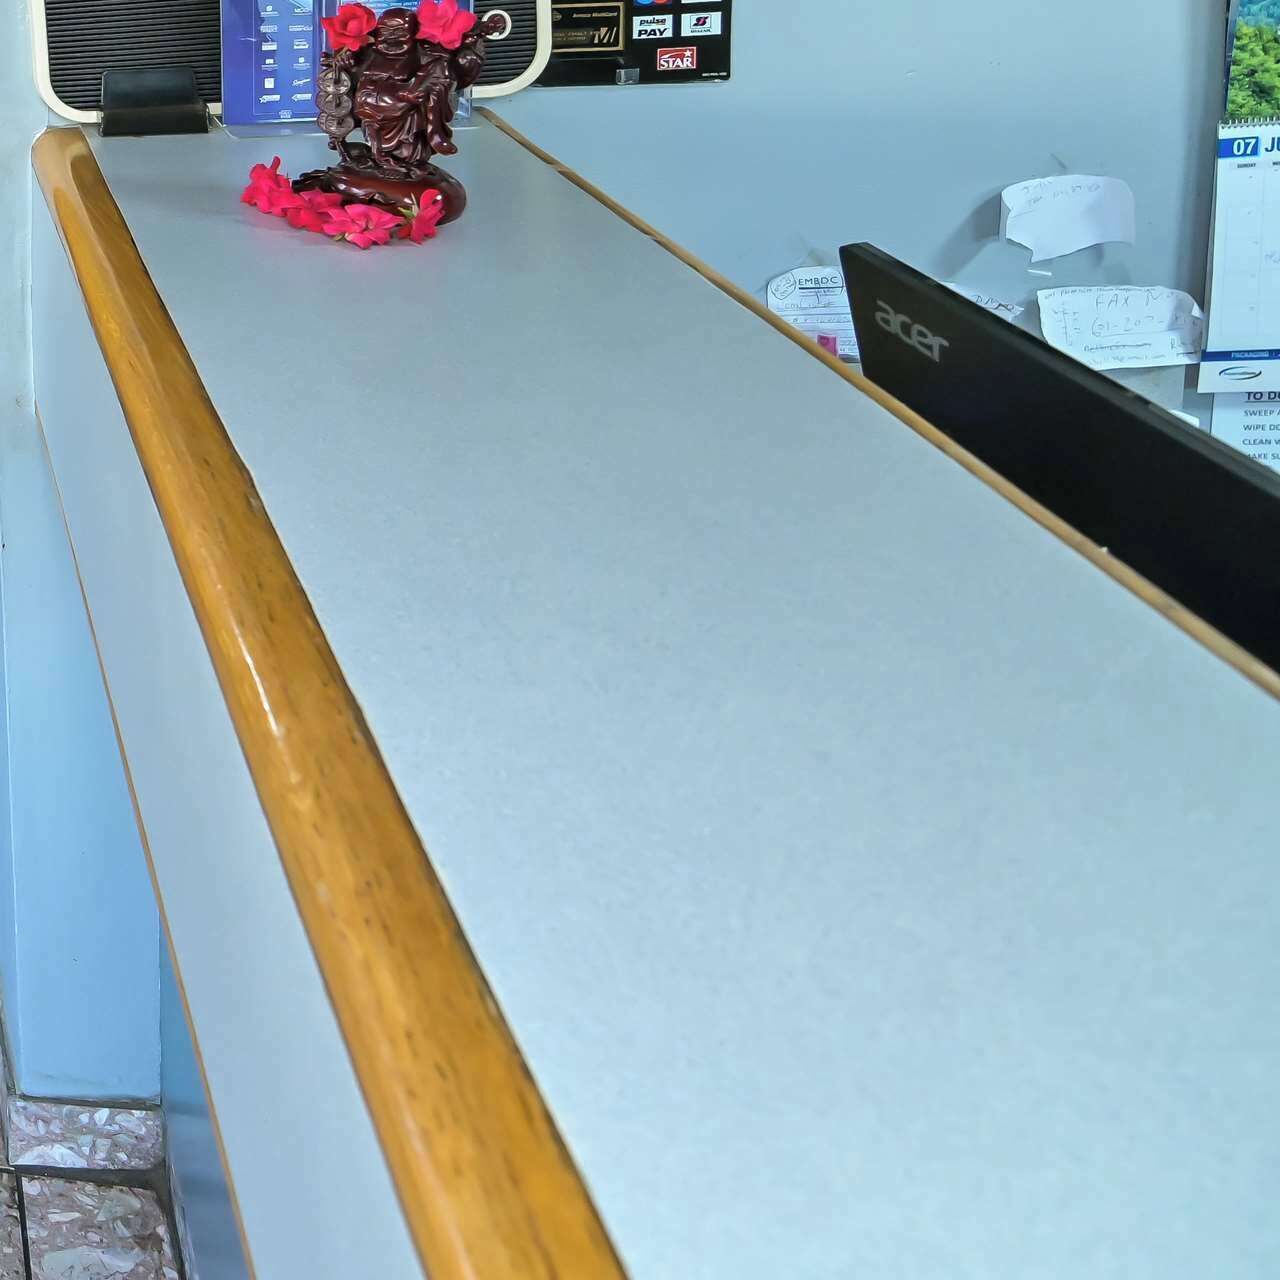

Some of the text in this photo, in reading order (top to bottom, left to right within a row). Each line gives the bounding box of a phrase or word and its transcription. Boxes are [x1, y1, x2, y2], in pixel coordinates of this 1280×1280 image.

[639, 16, 667, 26] pulse
[637, 28, 667, 38] PAY
[660, 57, 693, 70] STAR
[1232, 138, 1257, 156] 07
[874, 299, 950, 363] acer
[1245, 392, 1264, 401] TO
[1243, 409, 1275, 417] SWEEP
[1241, 438, 1272, 446] CLEAN
